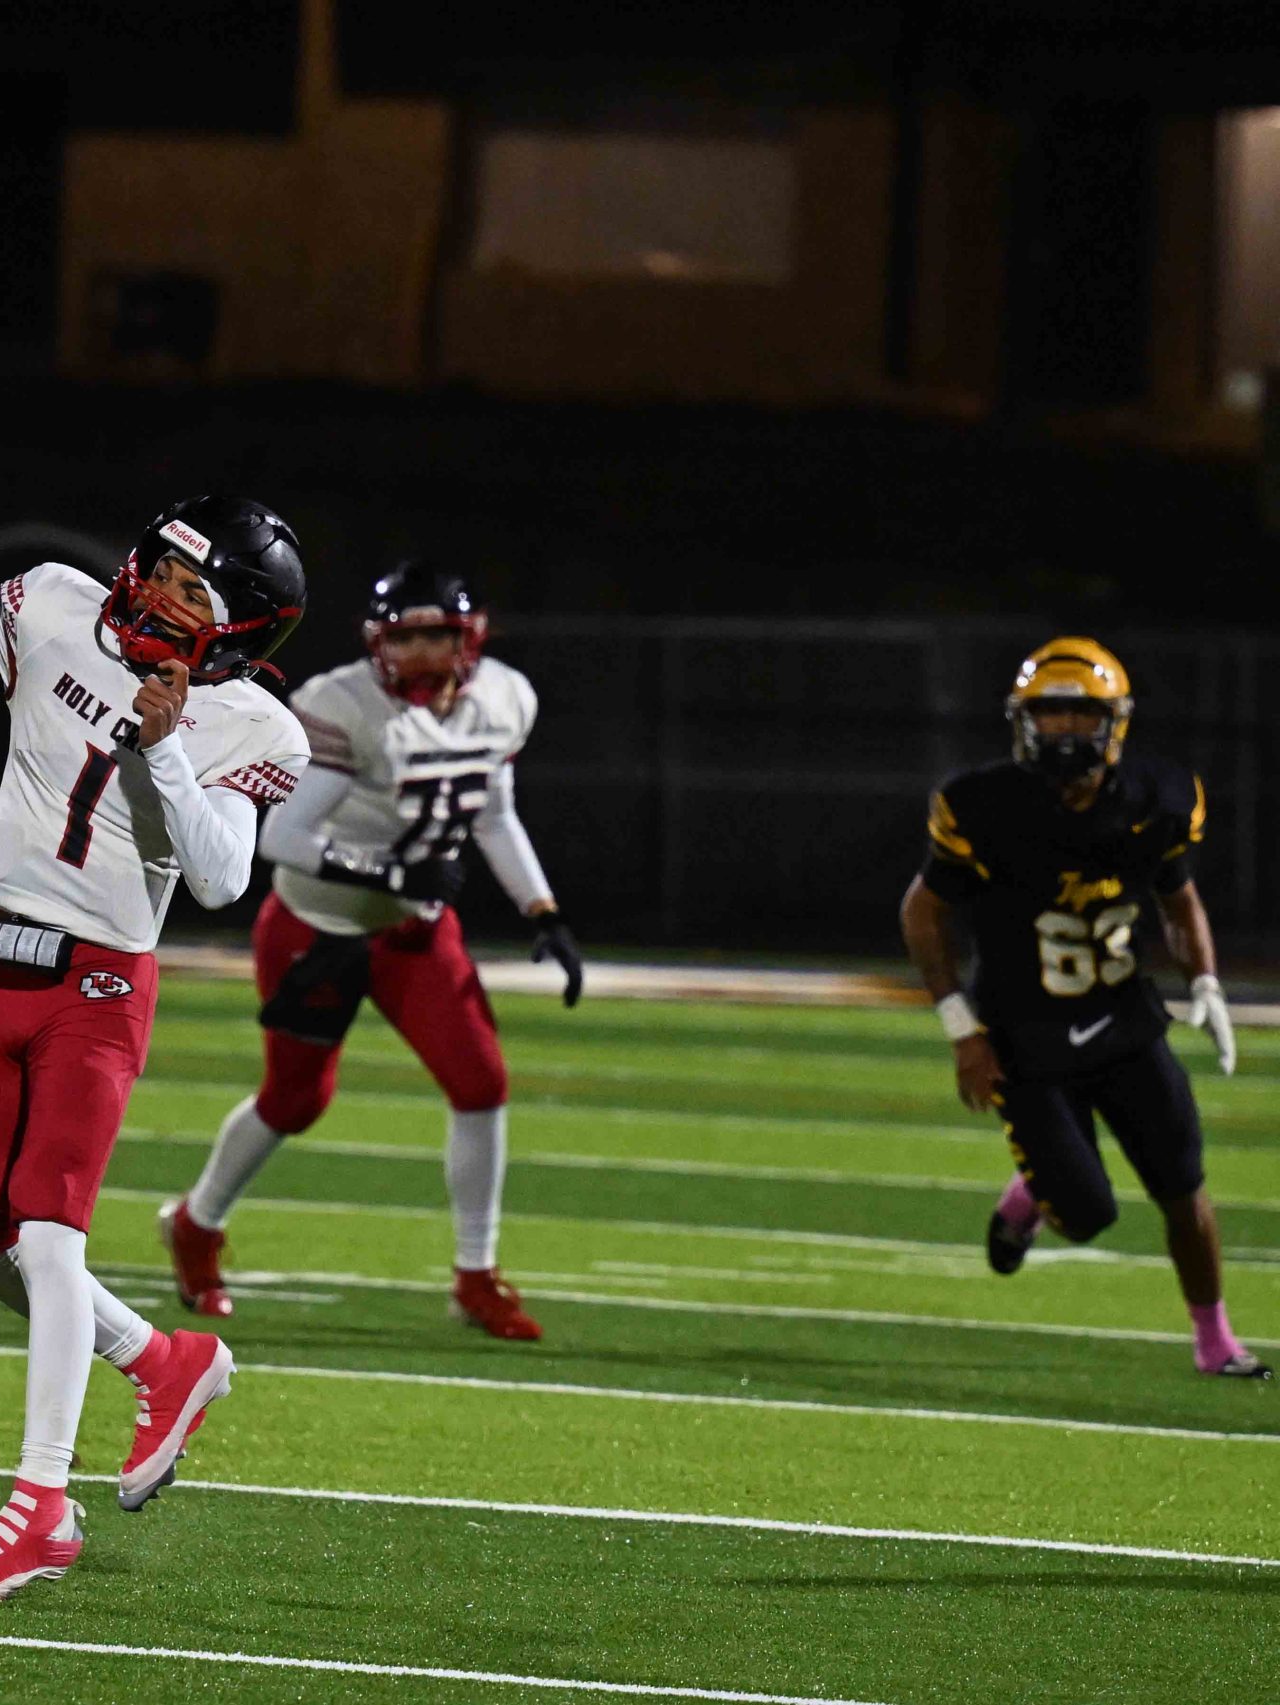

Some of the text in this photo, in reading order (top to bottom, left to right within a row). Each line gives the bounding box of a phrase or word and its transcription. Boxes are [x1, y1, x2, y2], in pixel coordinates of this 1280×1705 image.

[166, 522, 206, 553] Riddell
[52, 672, 113, 728] HOLY
[55, 740, 119, 871] 1
